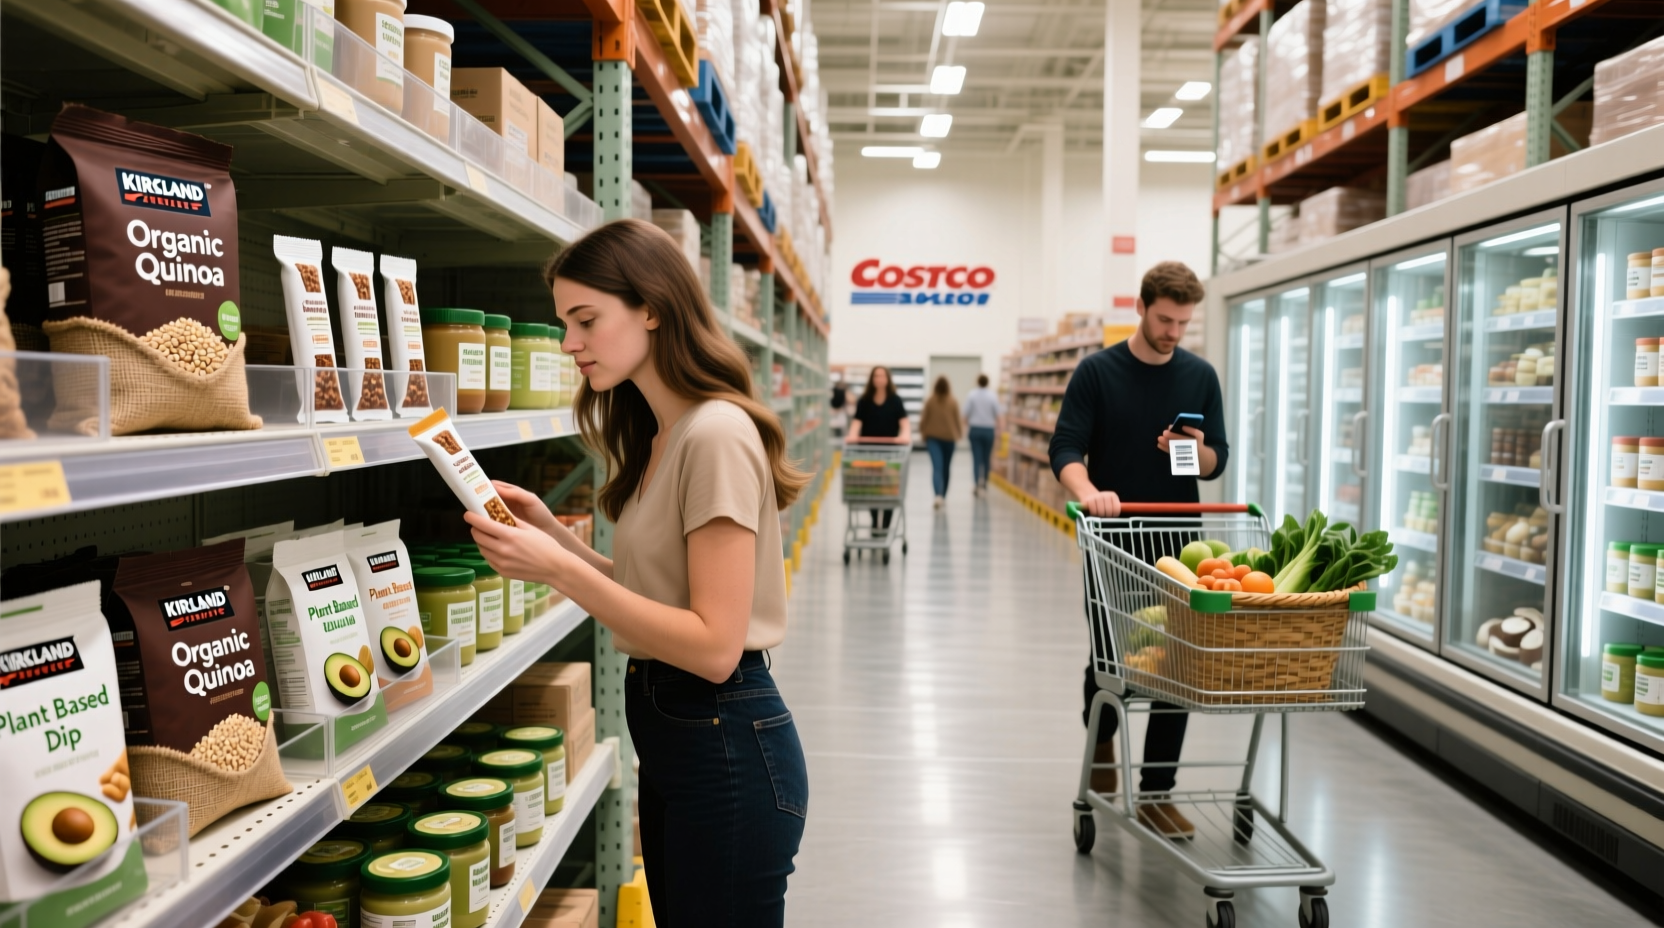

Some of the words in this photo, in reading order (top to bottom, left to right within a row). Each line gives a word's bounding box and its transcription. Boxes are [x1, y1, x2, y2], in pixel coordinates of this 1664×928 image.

[127, 219, 224, 258] Organic
[135, 252, 225, 287] Quinoa
[171, 628, 250, 668] Organic
[183, 659, 255, 697] Quinoa
[52, 683, 110, 720] Based
[44, 725, 82, 753] Dip
